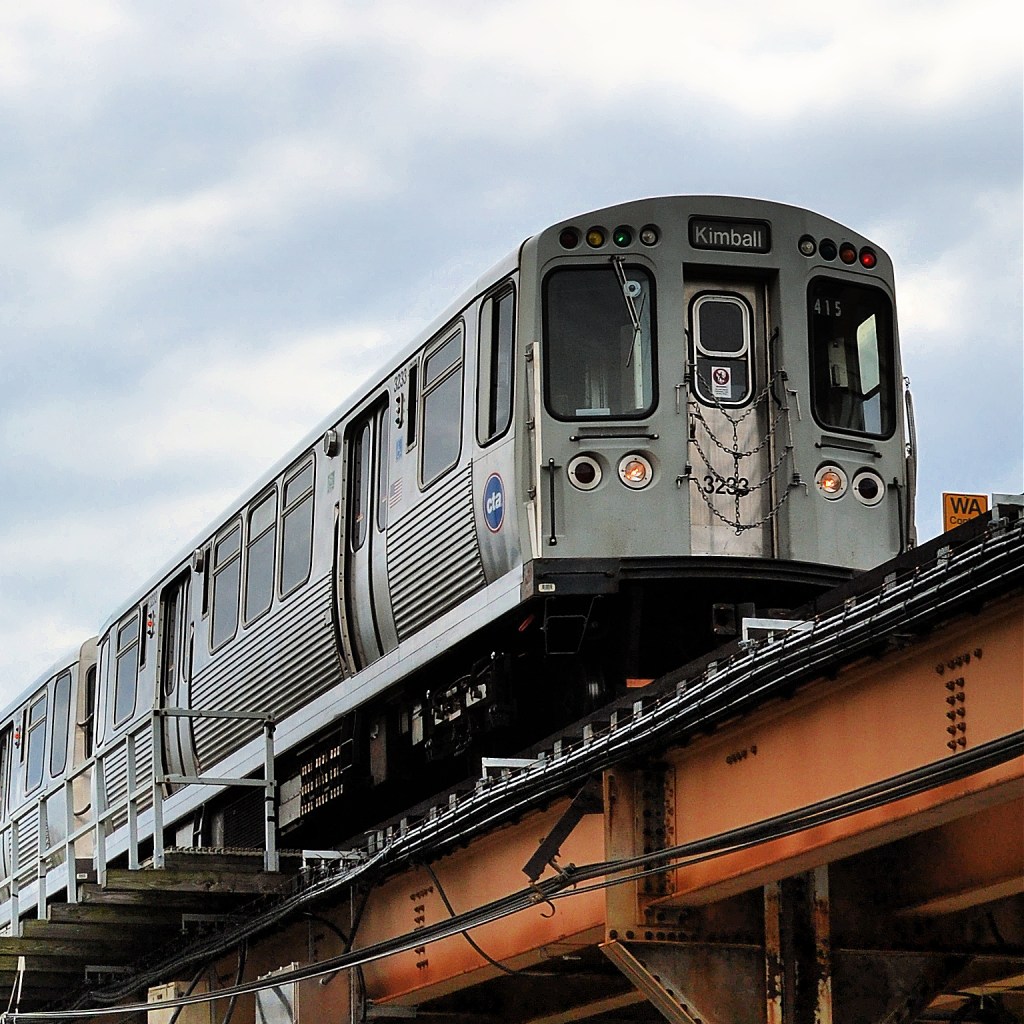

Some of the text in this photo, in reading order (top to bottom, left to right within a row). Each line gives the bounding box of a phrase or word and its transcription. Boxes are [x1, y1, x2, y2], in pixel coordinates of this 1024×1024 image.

[695, 226, 762, 247] Kimball
[814, 298, 842, 317] 415
[703, 475, 749, 496] 3233
[486, 491, 502, 514] cta
